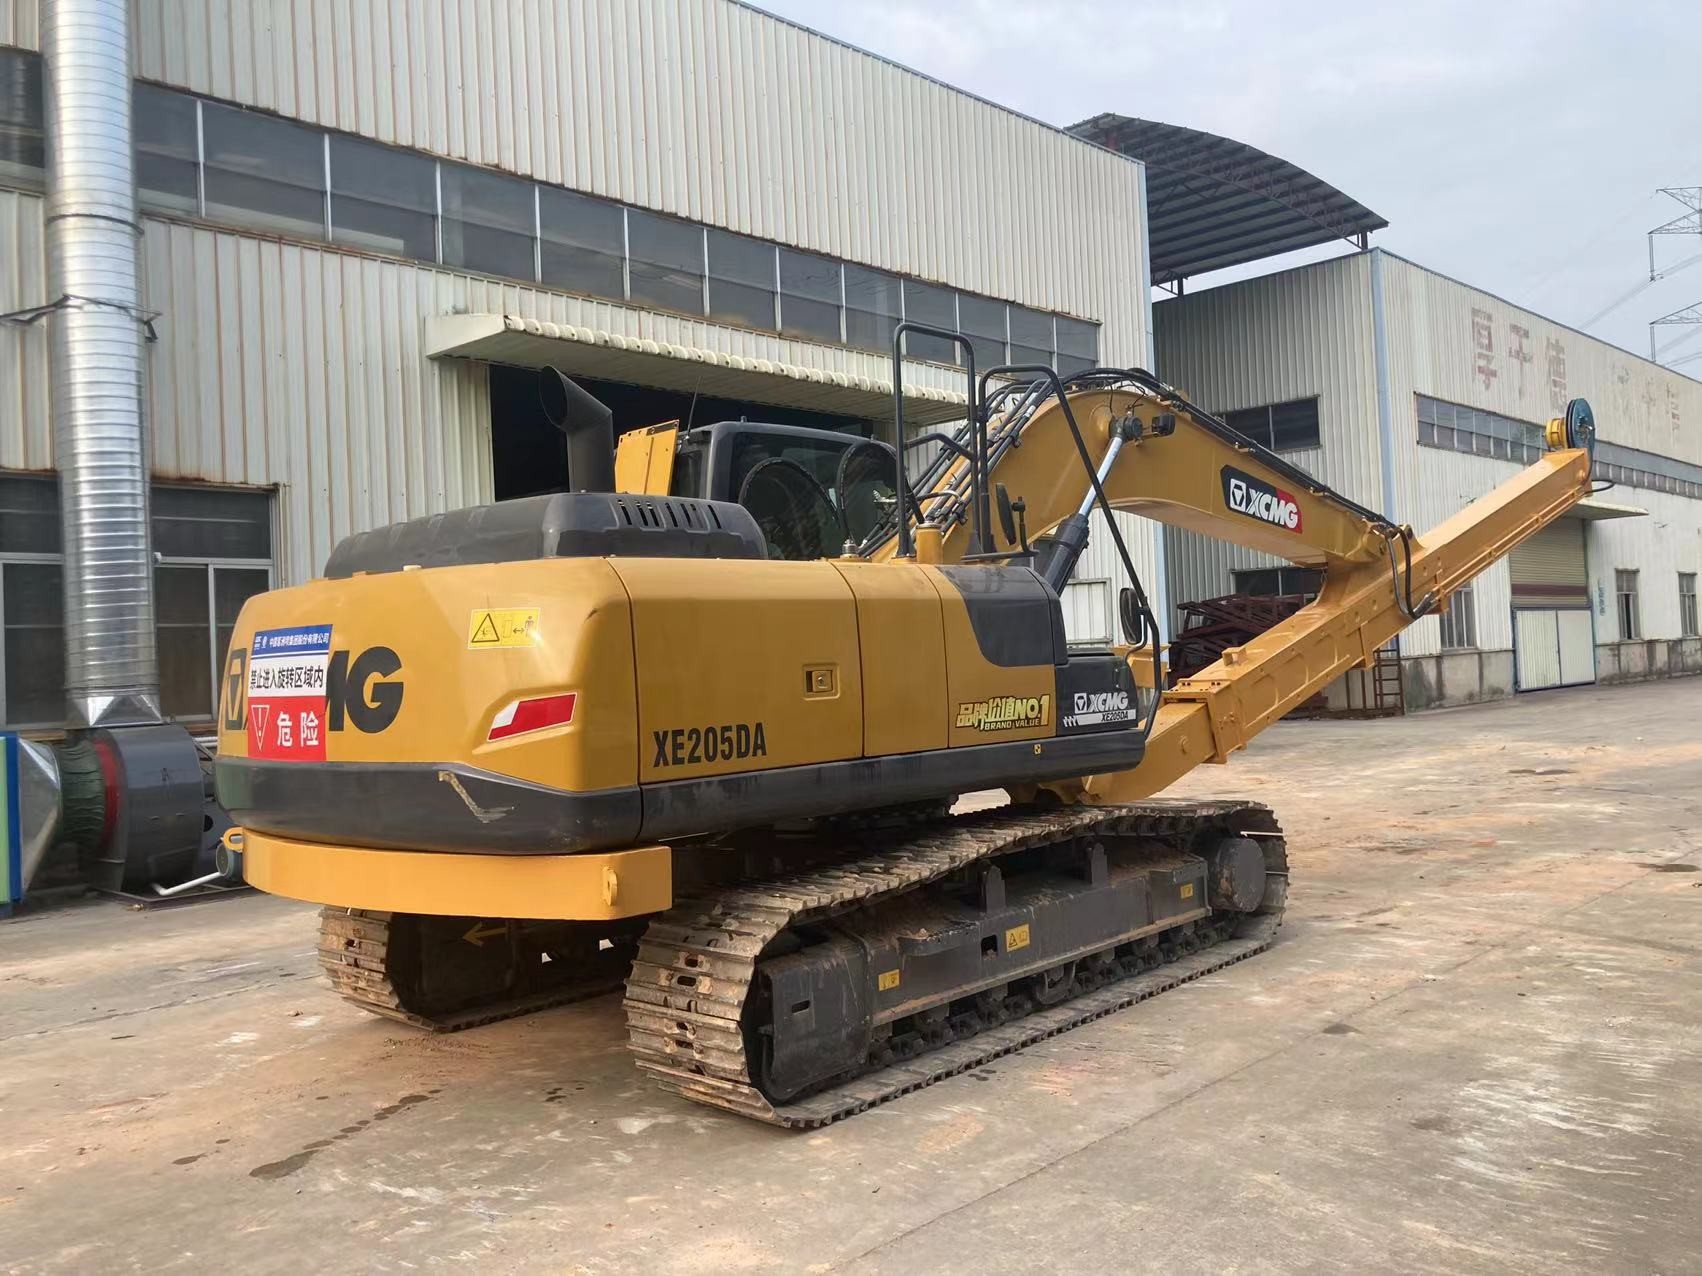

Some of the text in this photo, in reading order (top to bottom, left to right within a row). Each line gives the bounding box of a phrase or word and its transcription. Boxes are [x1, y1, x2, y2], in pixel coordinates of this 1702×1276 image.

[1245, 488, 1298, 529] XCMG
[249, 665, 324, 690] 禁止进入旋转区域内
[1087, 691, 1129, 712] XCMG
[984, 718, 1040, 731] BRAND VALUE
[1101, 711, 1129, 722] XE205DA
[652, 722, 767, 768] XE205DA
